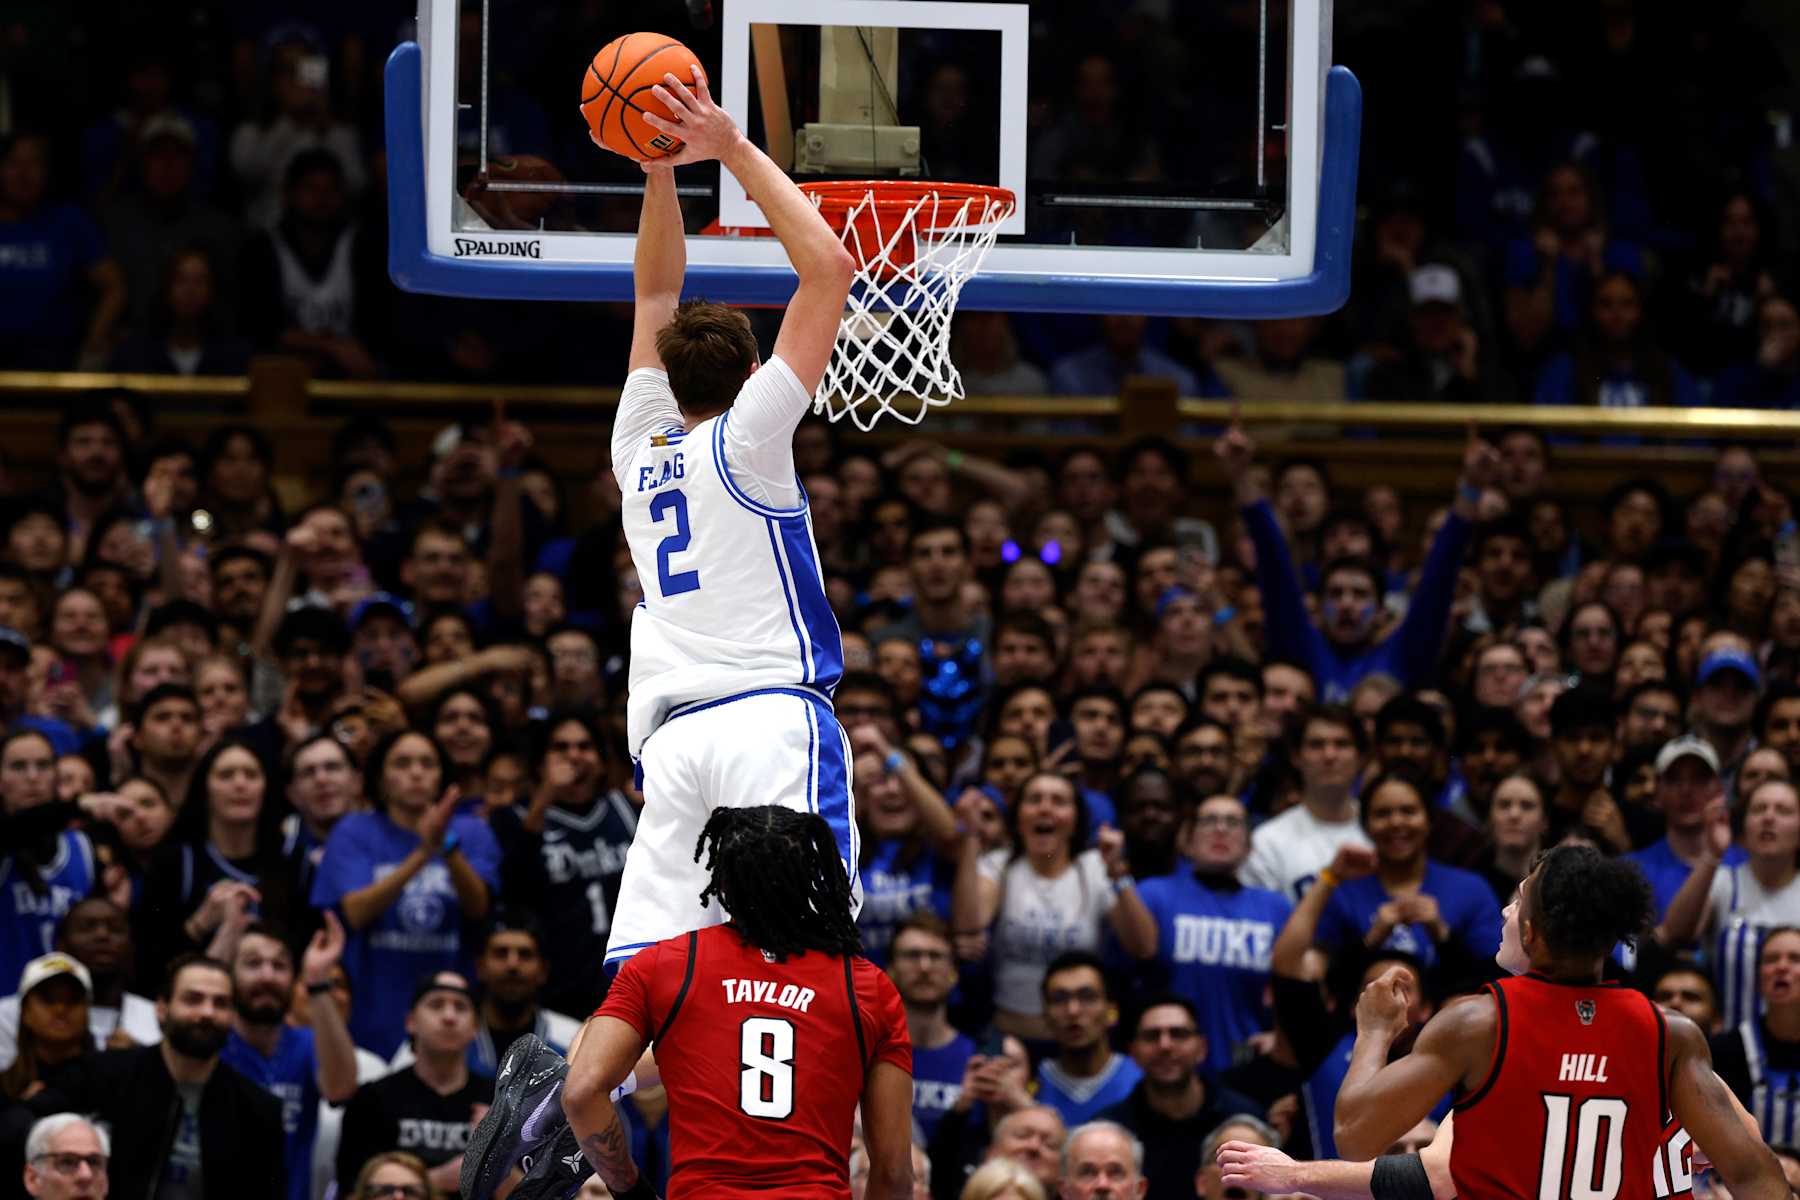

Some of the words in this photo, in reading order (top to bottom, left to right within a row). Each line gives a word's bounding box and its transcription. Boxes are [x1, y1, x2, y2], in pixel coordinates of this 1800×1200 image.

[454, 237, 541, 259] SPALDING
[649, 488, 701, 598] 2
[1172, 912, 1275, 974] DUKE
[721, 978, 816, 1014] TAYLOR
[739, 1015, 796, 1121] 8
[1558, 1053, 1609, 1084] HILL
[396, 1117, 469, 1151] DUK
[1538, 1092, 1630, 1200] 10
